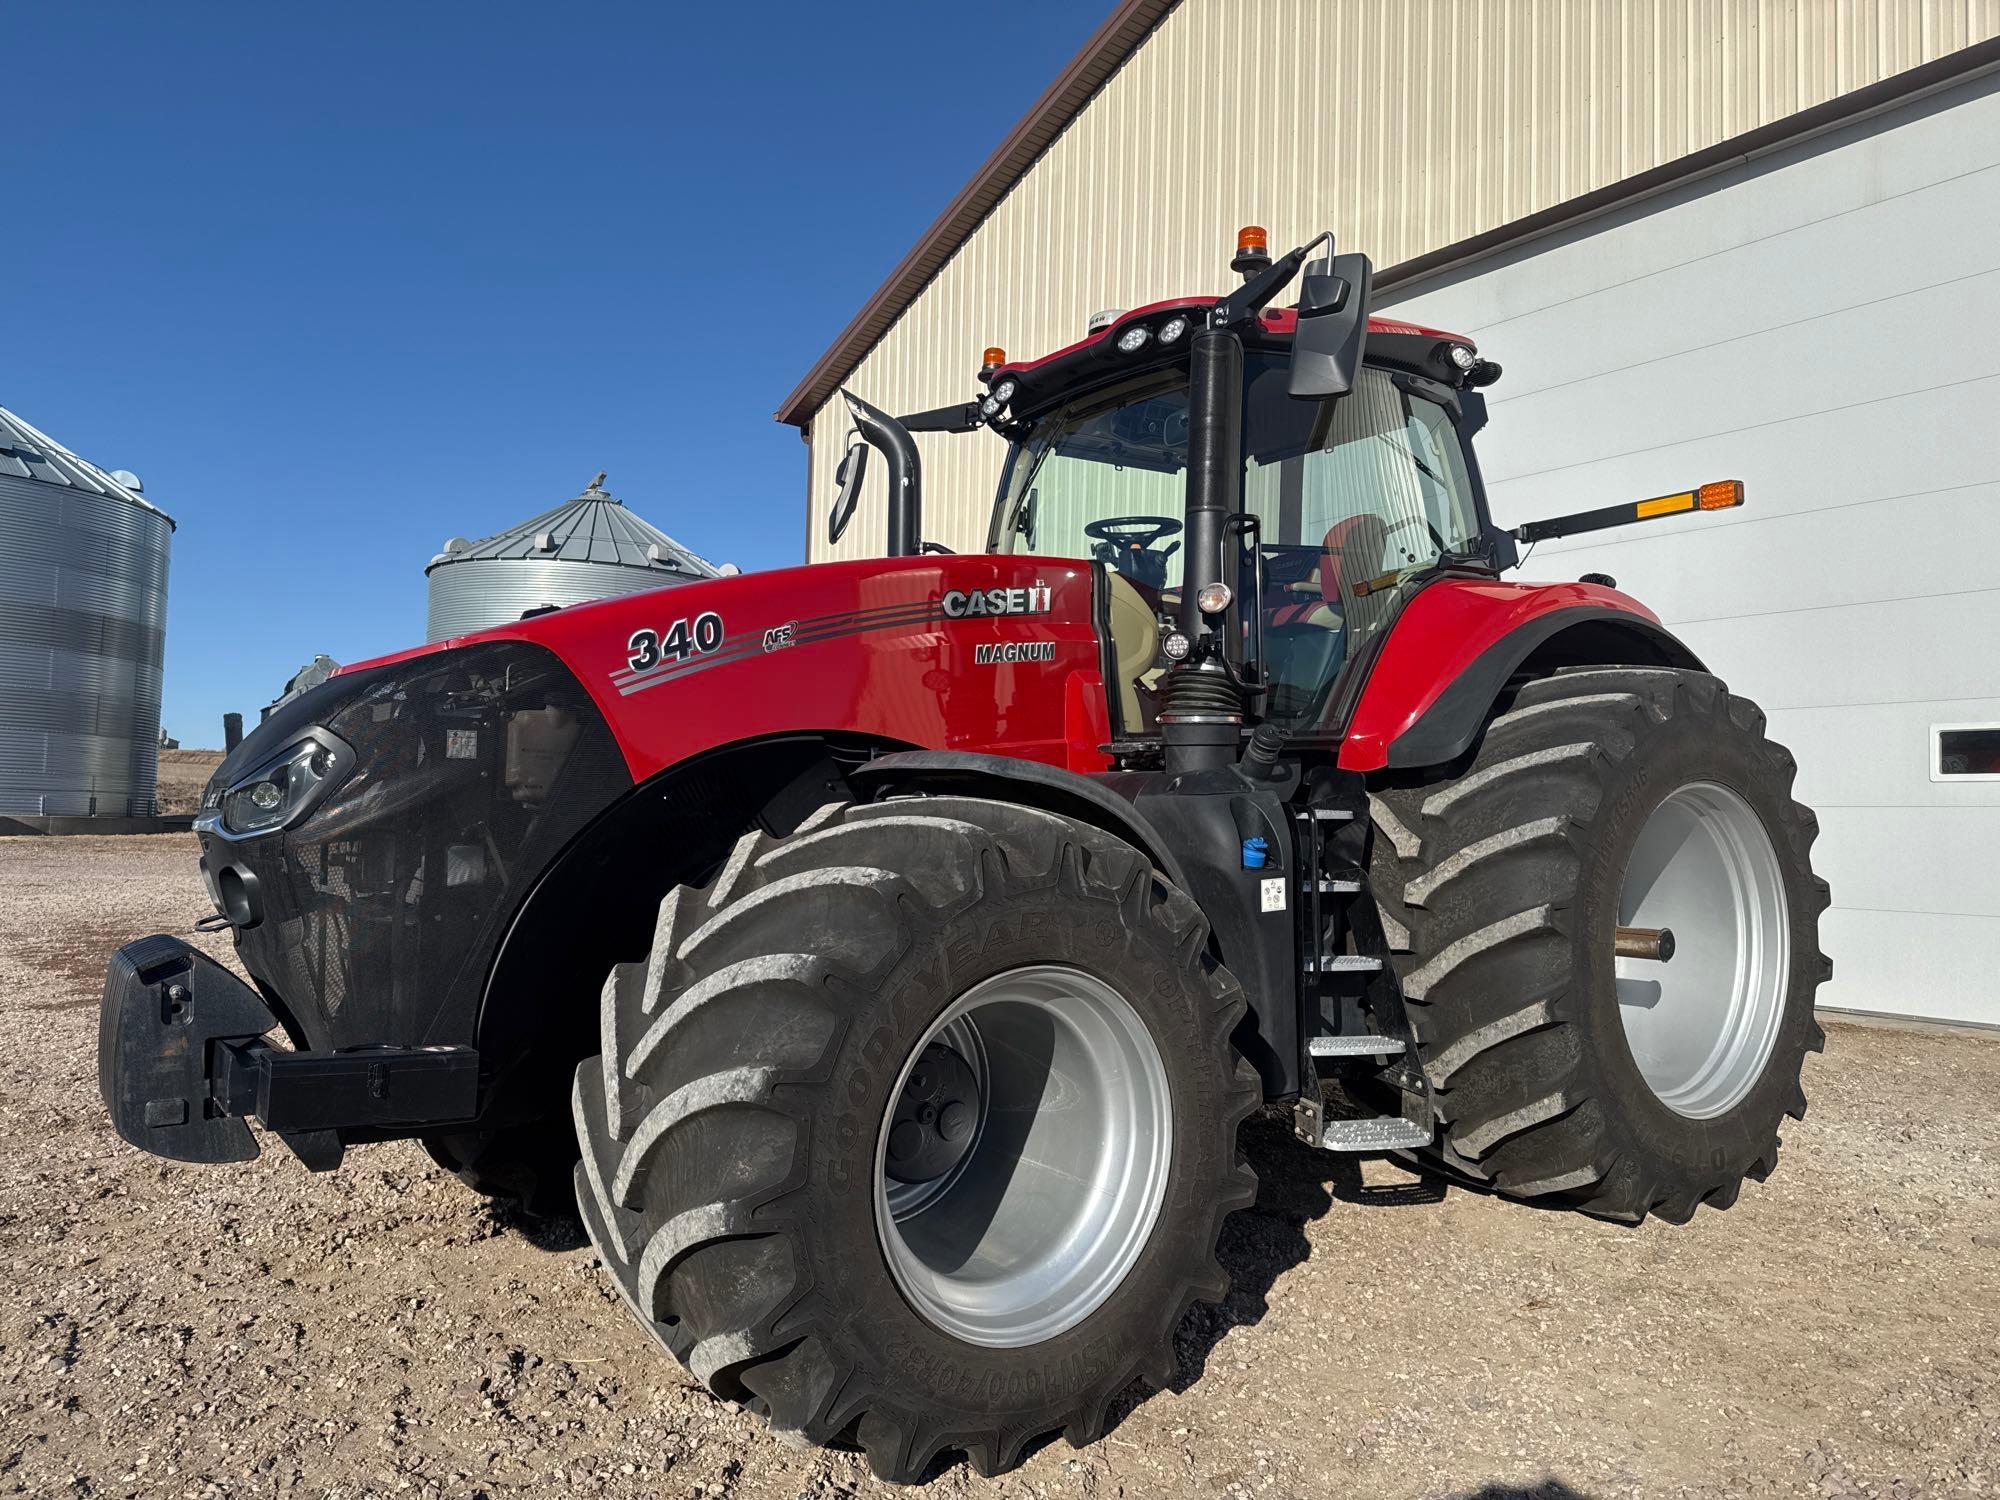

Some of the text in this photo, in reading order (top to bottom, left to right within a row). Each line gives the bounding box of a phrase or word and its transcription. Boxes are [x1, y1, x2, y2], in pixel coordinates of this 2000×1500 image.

[942, 587, 1025, 617] CASE
[625, 610, 725, 673] 340
[762, 625, 792, 648] AFS
[974, 640, 1056, 666] MAGNUM
[827, 911, 1050, 1195] GOODYEAR
